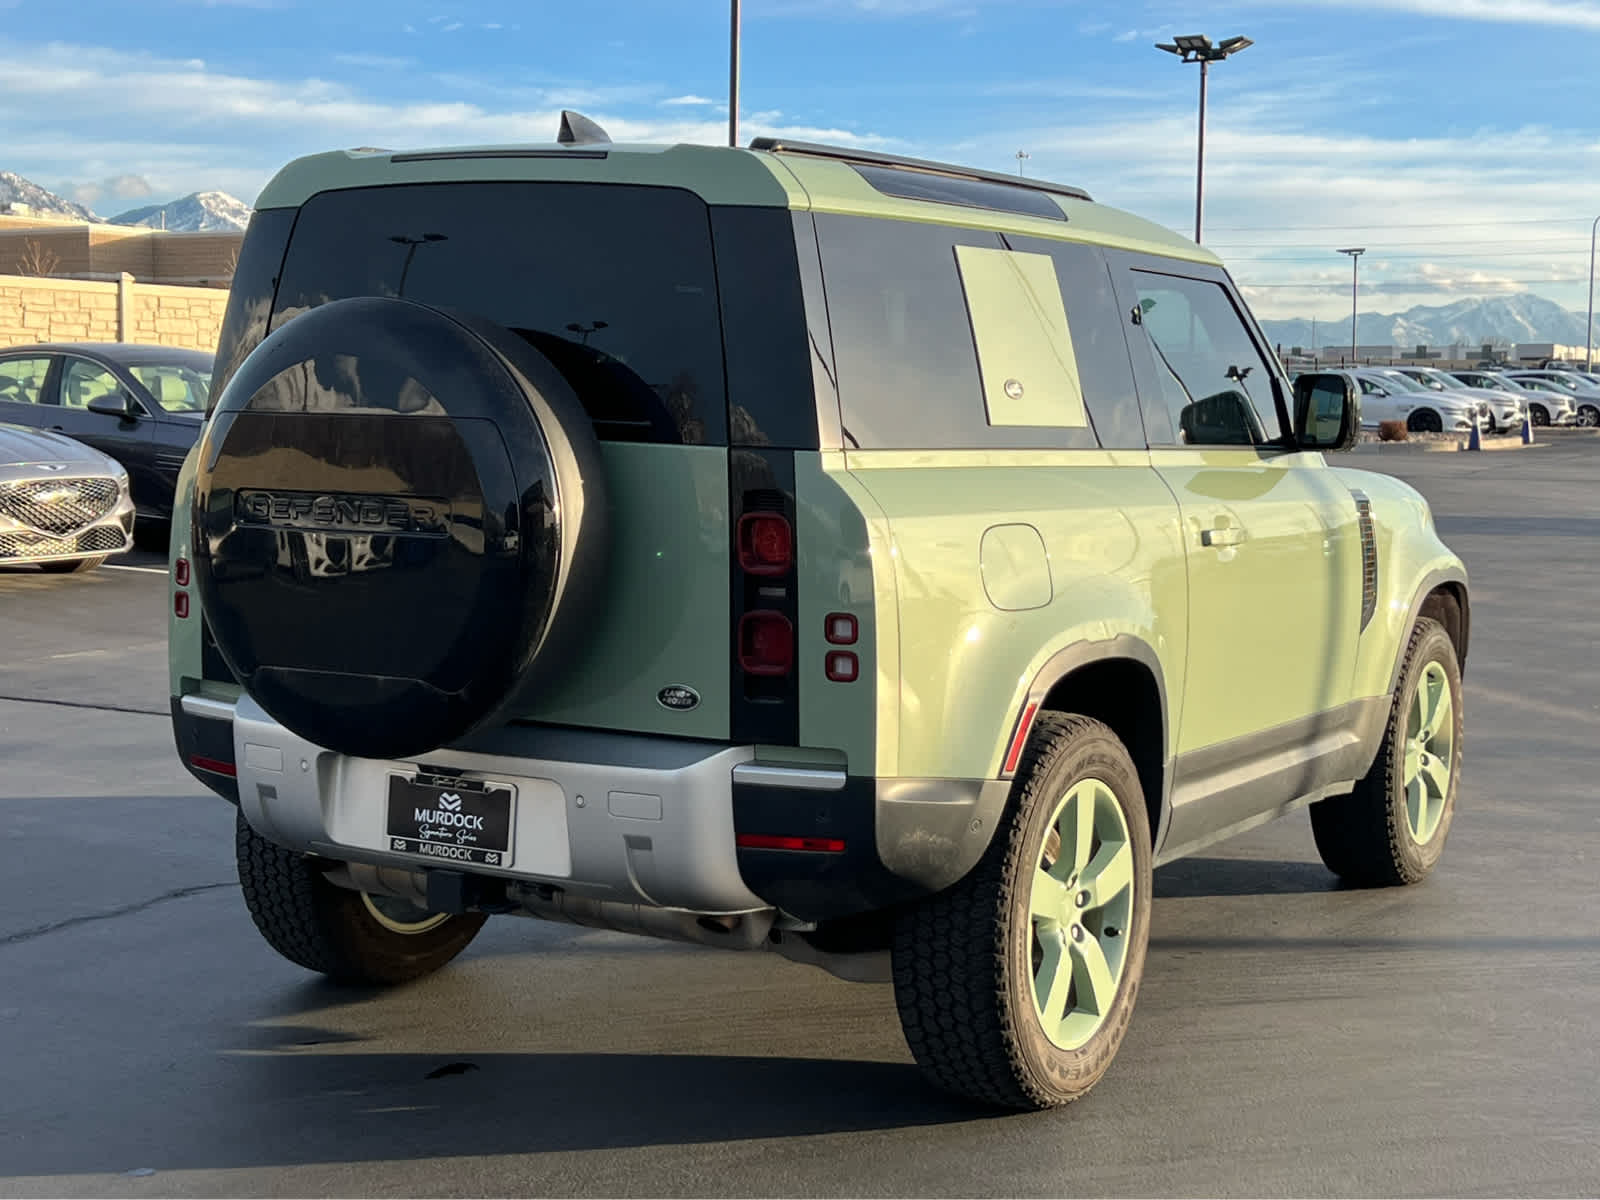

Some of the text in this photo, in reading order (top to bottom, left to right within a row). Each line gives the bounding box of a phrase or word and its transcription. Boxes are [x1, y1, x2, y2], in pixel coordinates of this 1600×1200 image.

[248, 493, 446, 532] DEFENDER
[414, 808, 484, 830] MURDOCK
[419, 843, 473, 861] MURDOCK
